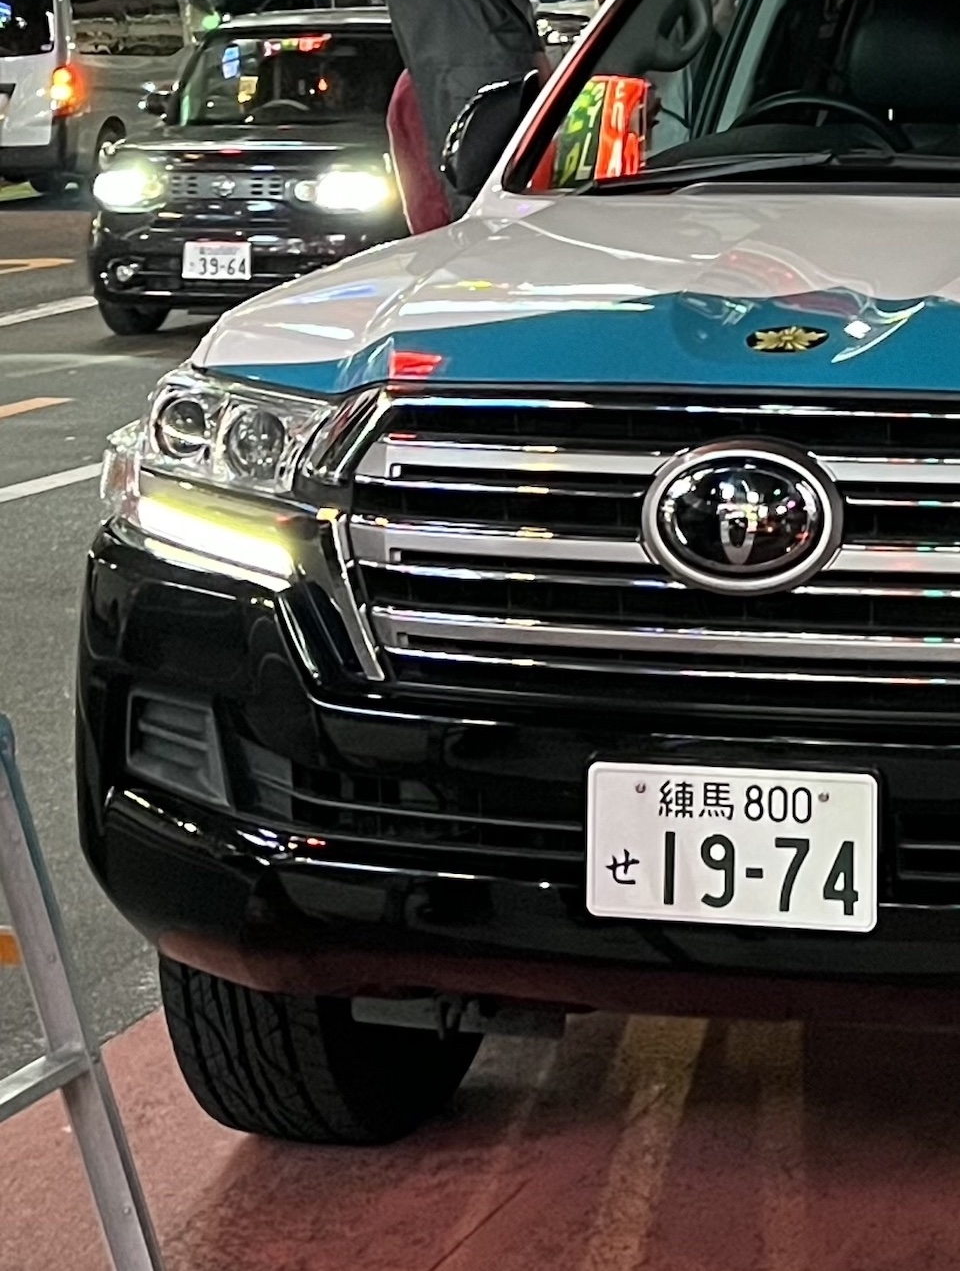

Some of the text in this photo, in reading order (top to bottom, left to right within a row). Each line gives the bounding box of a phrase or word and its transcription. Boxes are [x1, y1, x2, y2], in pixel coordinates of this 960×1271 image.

[198, 257, 247, 276] 39-64
[658, 780, 813, 824] 練馬 800
[605, 831, 859, 916] せ 19-74
